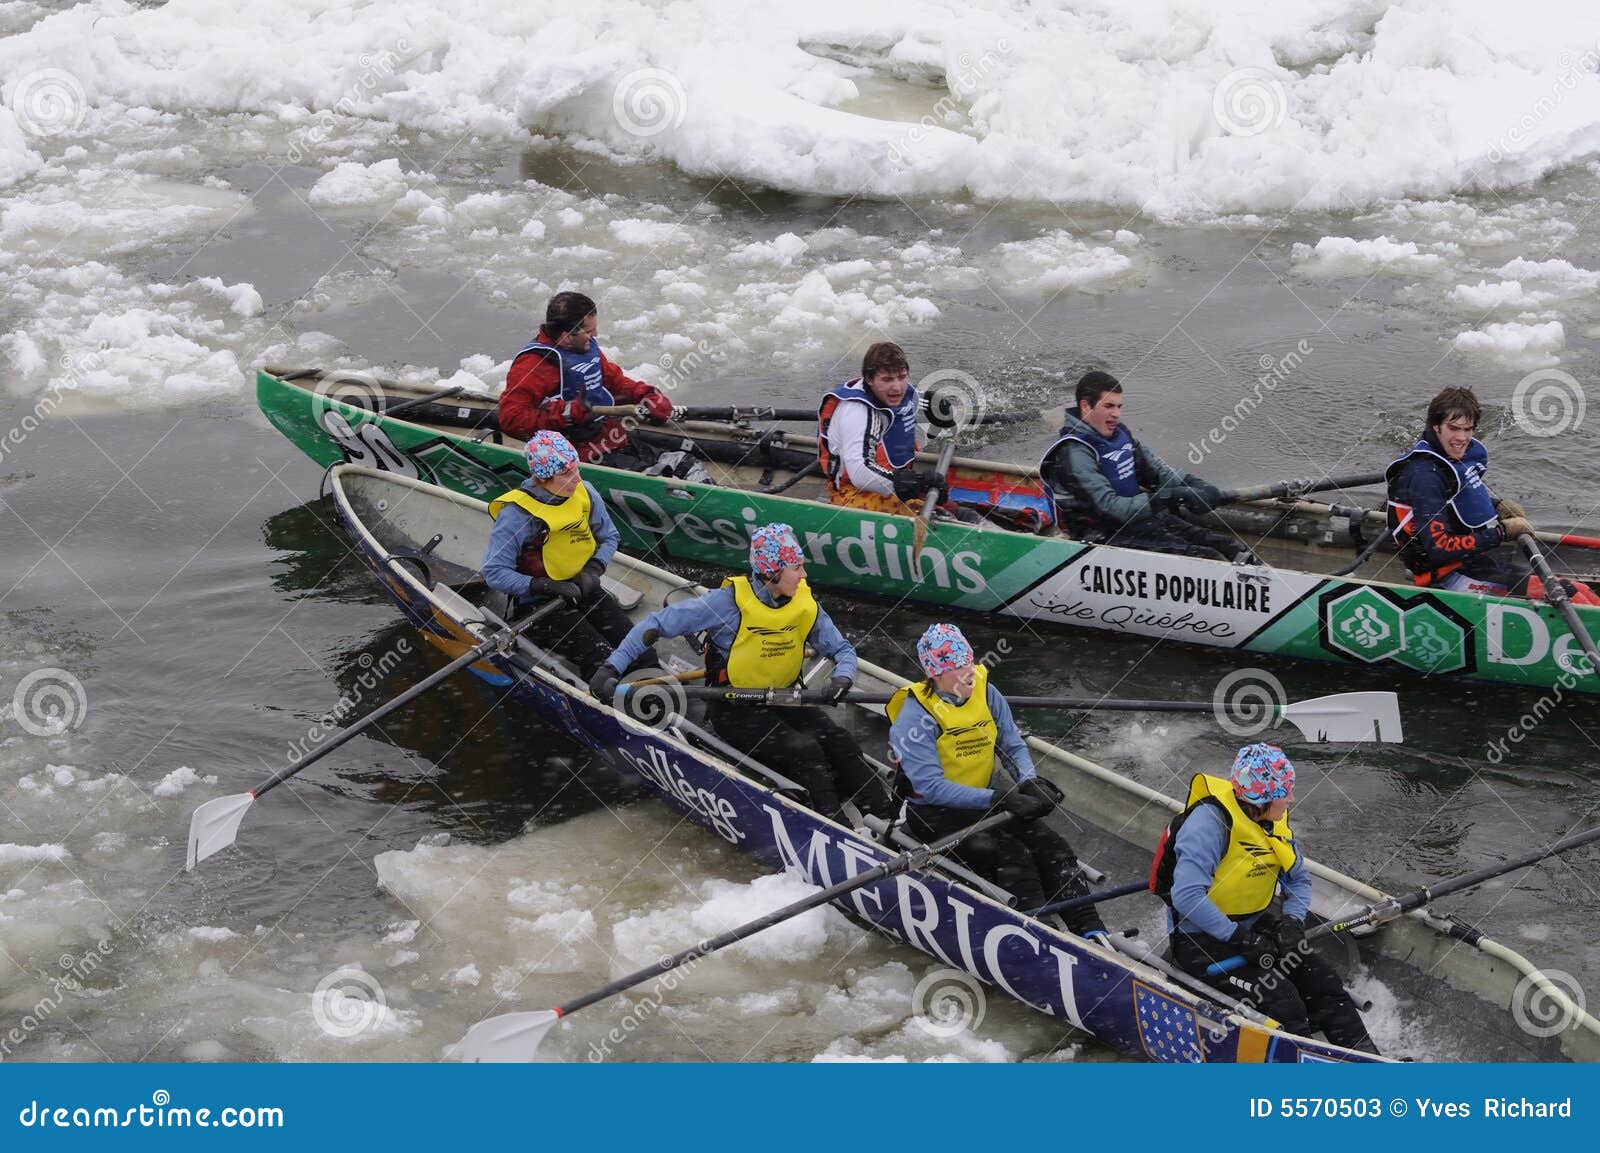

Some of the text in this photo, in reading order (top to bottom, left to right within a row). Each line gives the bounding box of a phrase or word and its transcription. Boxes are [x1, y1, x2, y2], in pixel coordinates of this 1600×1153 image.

[609, 488, 986, 595] Desrdins
[1030, 599, 1235, 638] de Québec
[1080, 564, 1271, 613] CAISSE POPULAIRE
[618, 744, 746, 845] Collège
